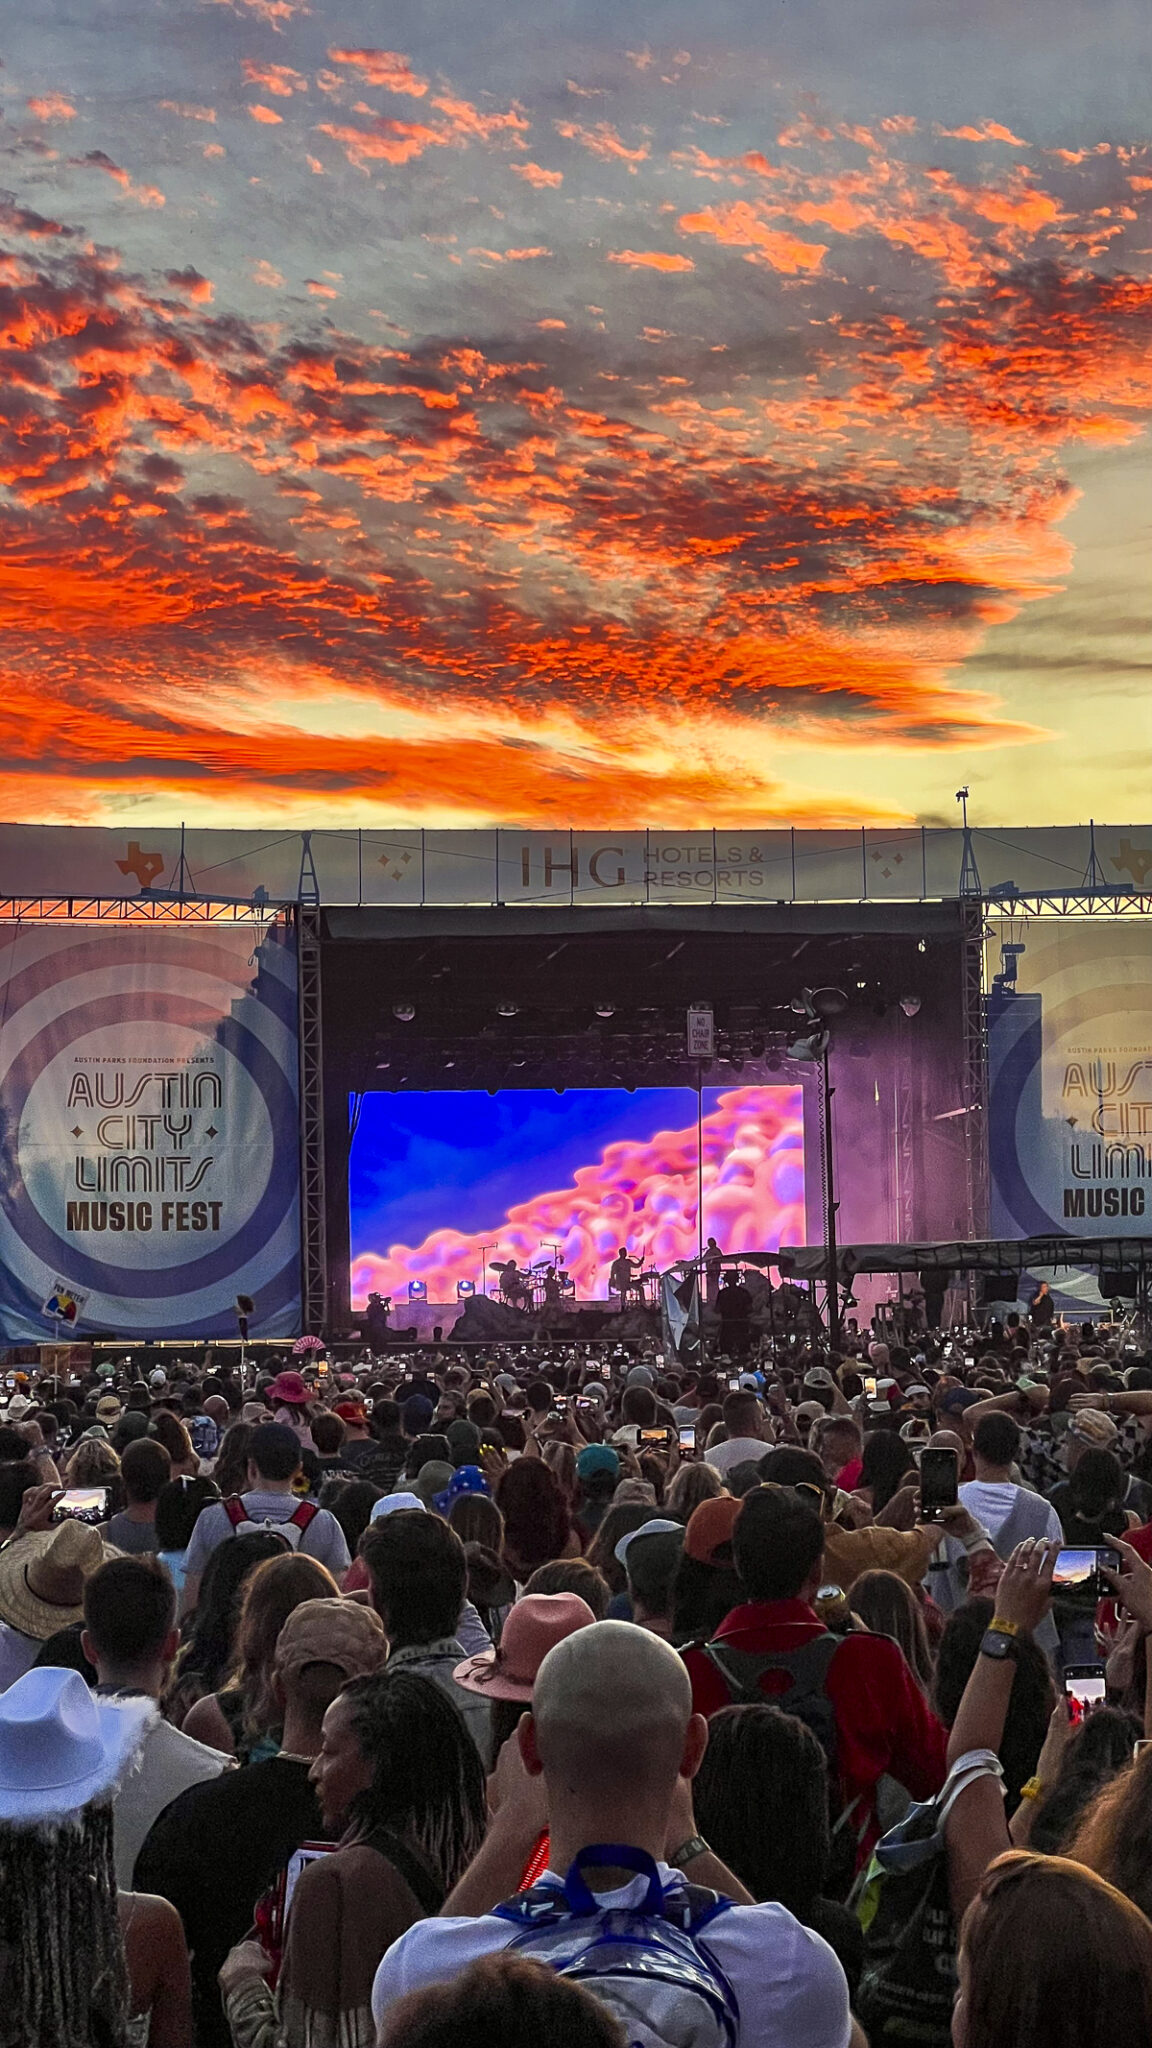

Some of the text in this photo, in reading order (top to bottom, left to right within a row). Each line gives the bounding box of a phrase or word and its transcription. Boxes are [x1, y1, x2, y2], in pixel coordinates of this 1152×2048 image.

[521, 847, 625, 888] IHG
[643, 847, 764, 864] HOTELS &
[643, 871, 764, 887] RESORTS
[692, 1029, 710, 1038] CHAIR
[696, 1017, 705, 1027] NO
[694, 1040, 709, 1050] ZONE
[67, 1072, 222, 1109] AUSTIN
[97, 1115, 192, 1150] CITY
[75, 1156, 213, 1192] LIMITS
[66, 1201, 223, 1231] MUSIC FEST
[1063, 1187, 1145, 1218] MUSIC
